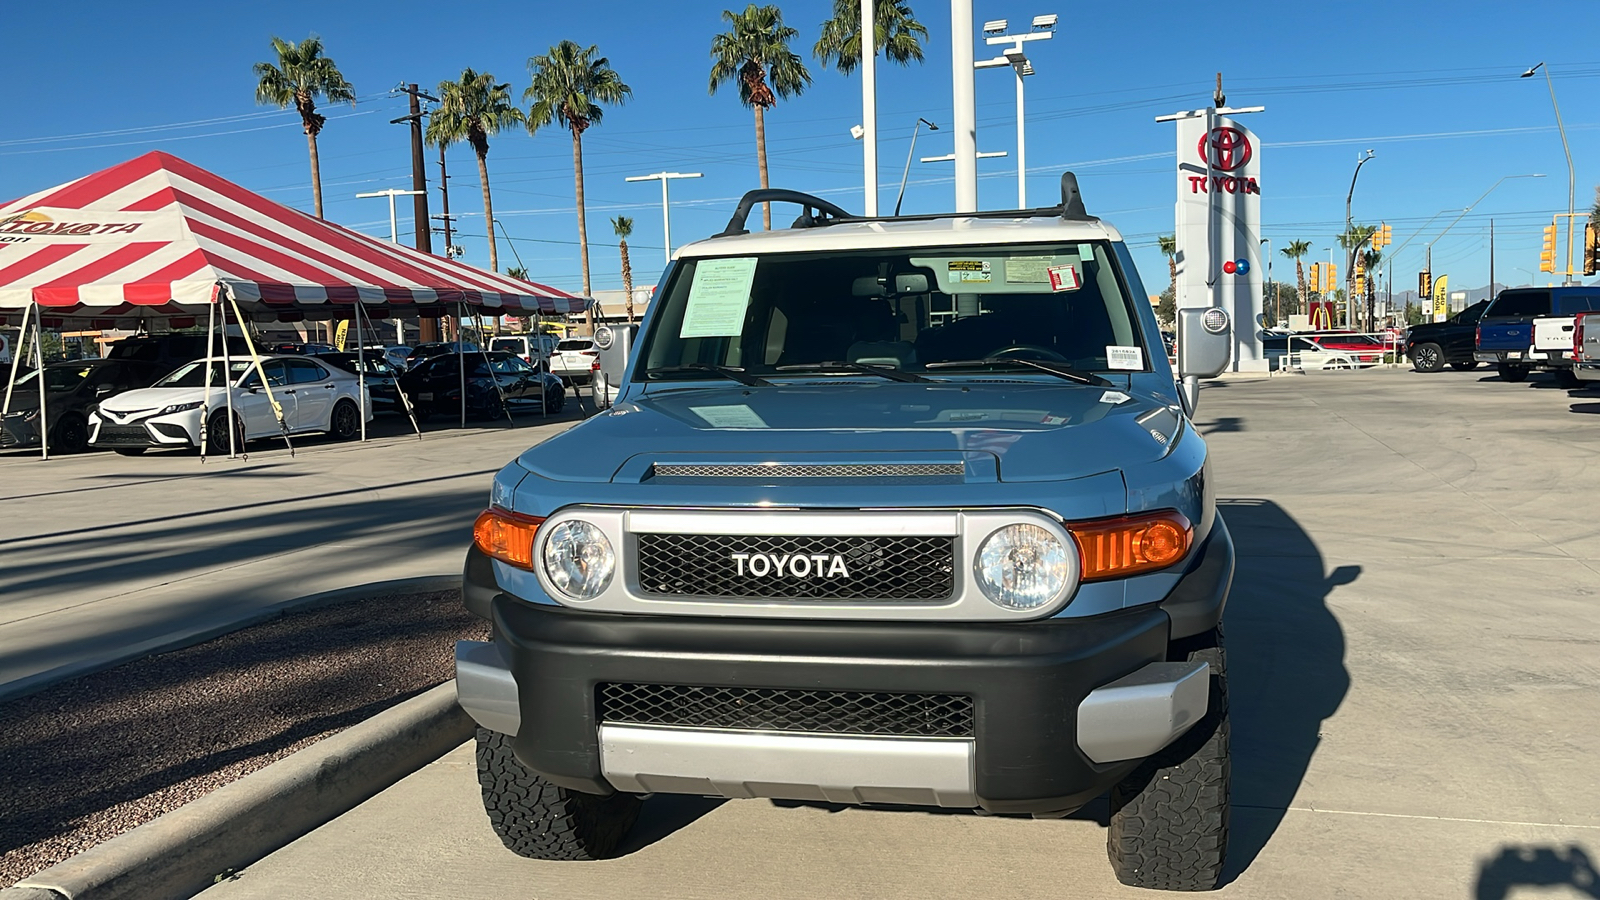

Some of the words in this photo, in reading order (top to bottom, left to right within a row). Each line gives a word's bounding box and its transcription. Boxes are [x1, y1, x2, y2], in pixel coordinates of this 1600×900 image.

[1188, 176, 1260, 195] TOYOTA
[4, 220, 143, 235] TOYOTA
[731, 554, 850, 578] TOYOTA
